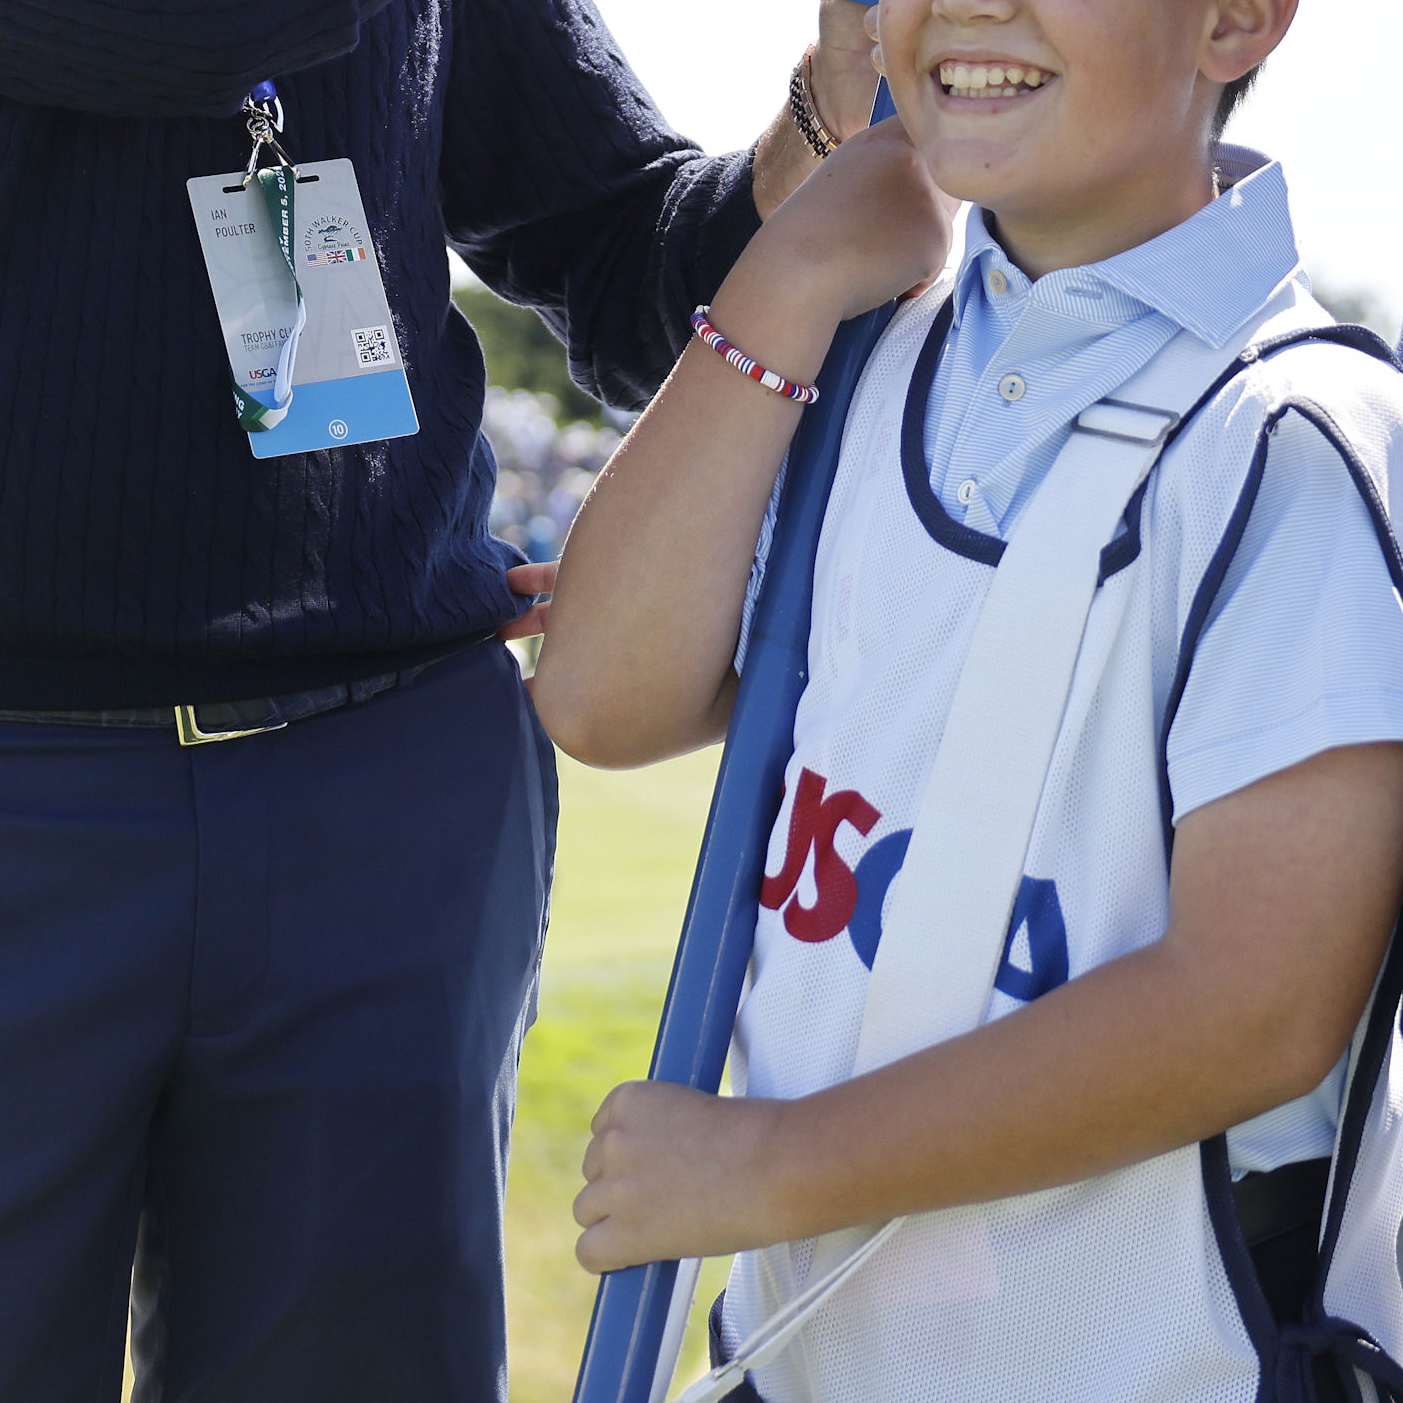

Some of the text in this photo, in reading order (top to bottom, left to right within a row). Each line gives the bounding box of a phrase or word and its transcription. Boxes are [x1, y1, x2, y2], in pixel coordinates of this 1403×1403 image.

[276, 169, 288, 192] 202
[210, 209, 227, 220] IAN
[215, 223, 256, 238] POULTER
[312, 215, 349, 227] WALKER
[350, 226, 363, 245] CUP
[241, 330, 276, 344] TROPHY
[249, 367, 277, 380] USGA
[332, 424, 344, 435] 10
